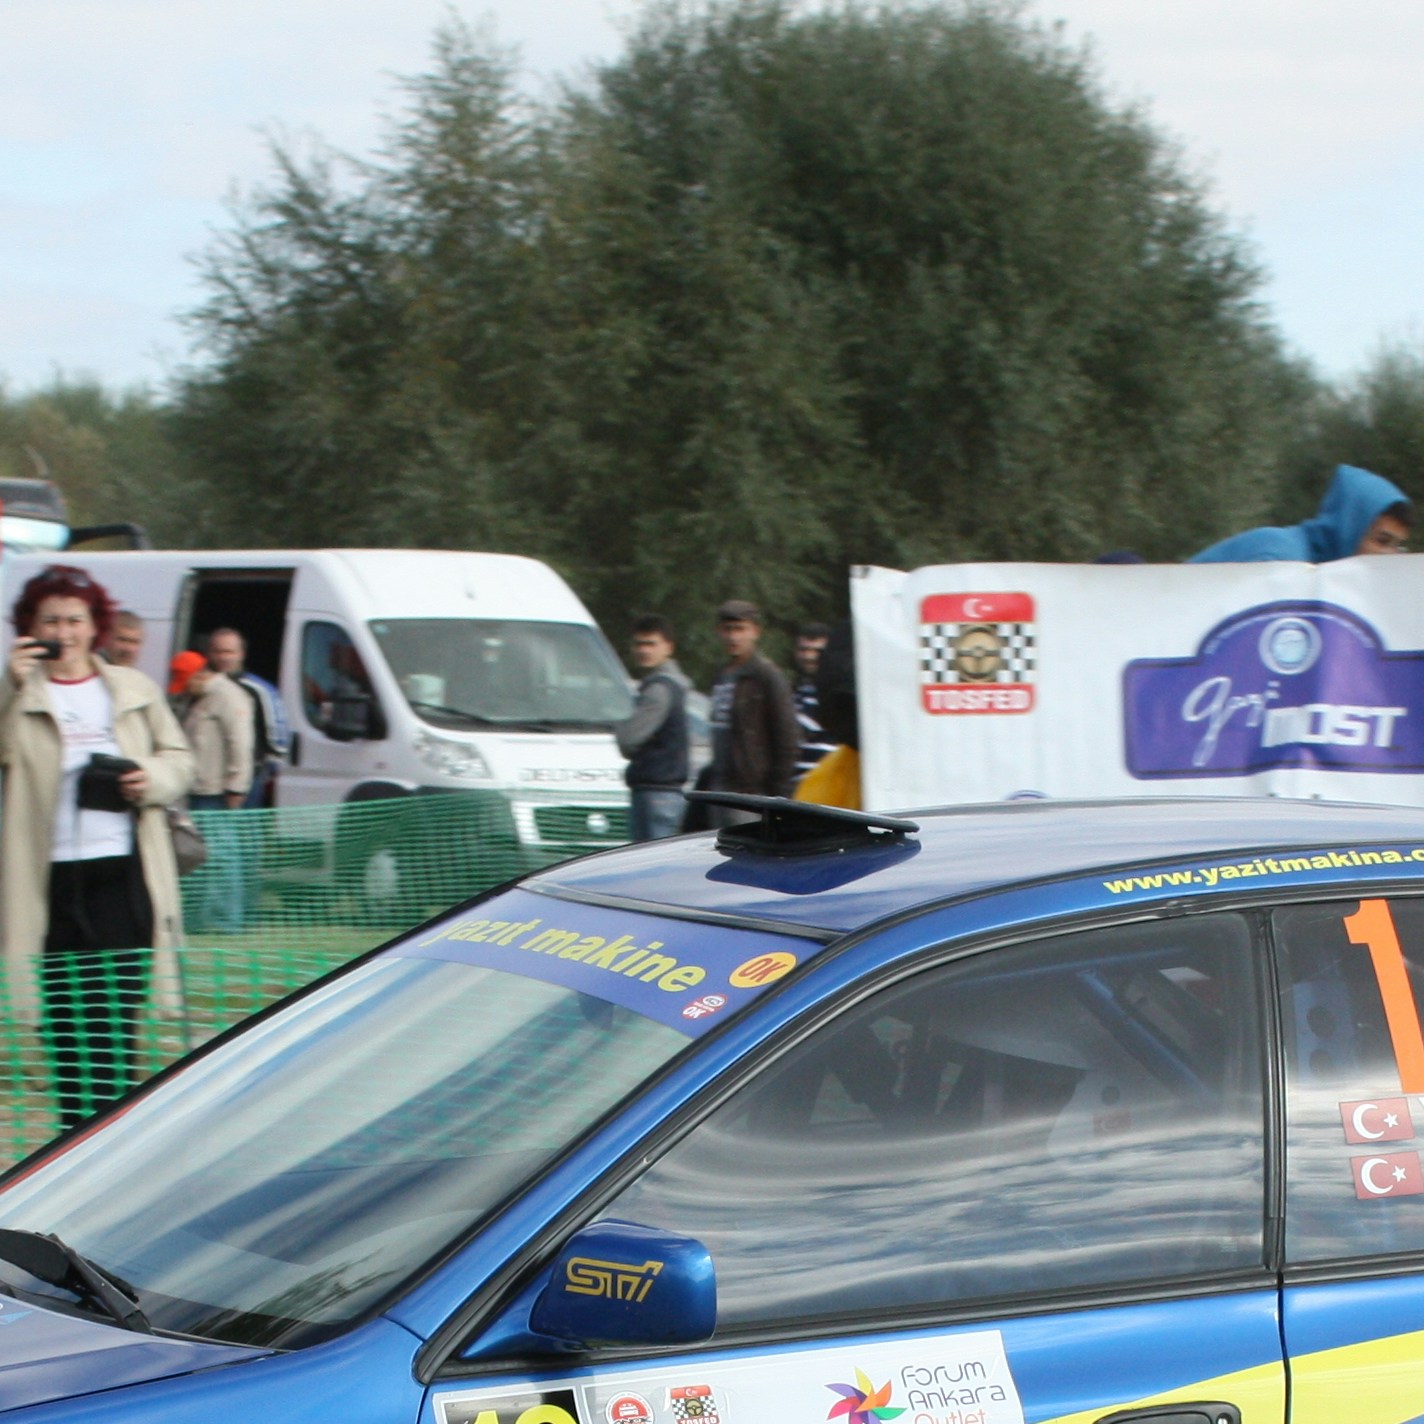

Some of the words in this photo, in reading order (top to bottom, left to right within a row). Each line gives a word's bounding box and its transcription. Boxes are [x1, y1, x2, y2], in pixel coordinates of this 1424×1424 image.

[926, 687, 1032, 712] TOSFED
[519, 927, 707, 993] makine
[736, 957, 790, 983] OK
[901, 1361, 987, 1388] Forum
[907, 1384, 1007, 1412] Ankara
